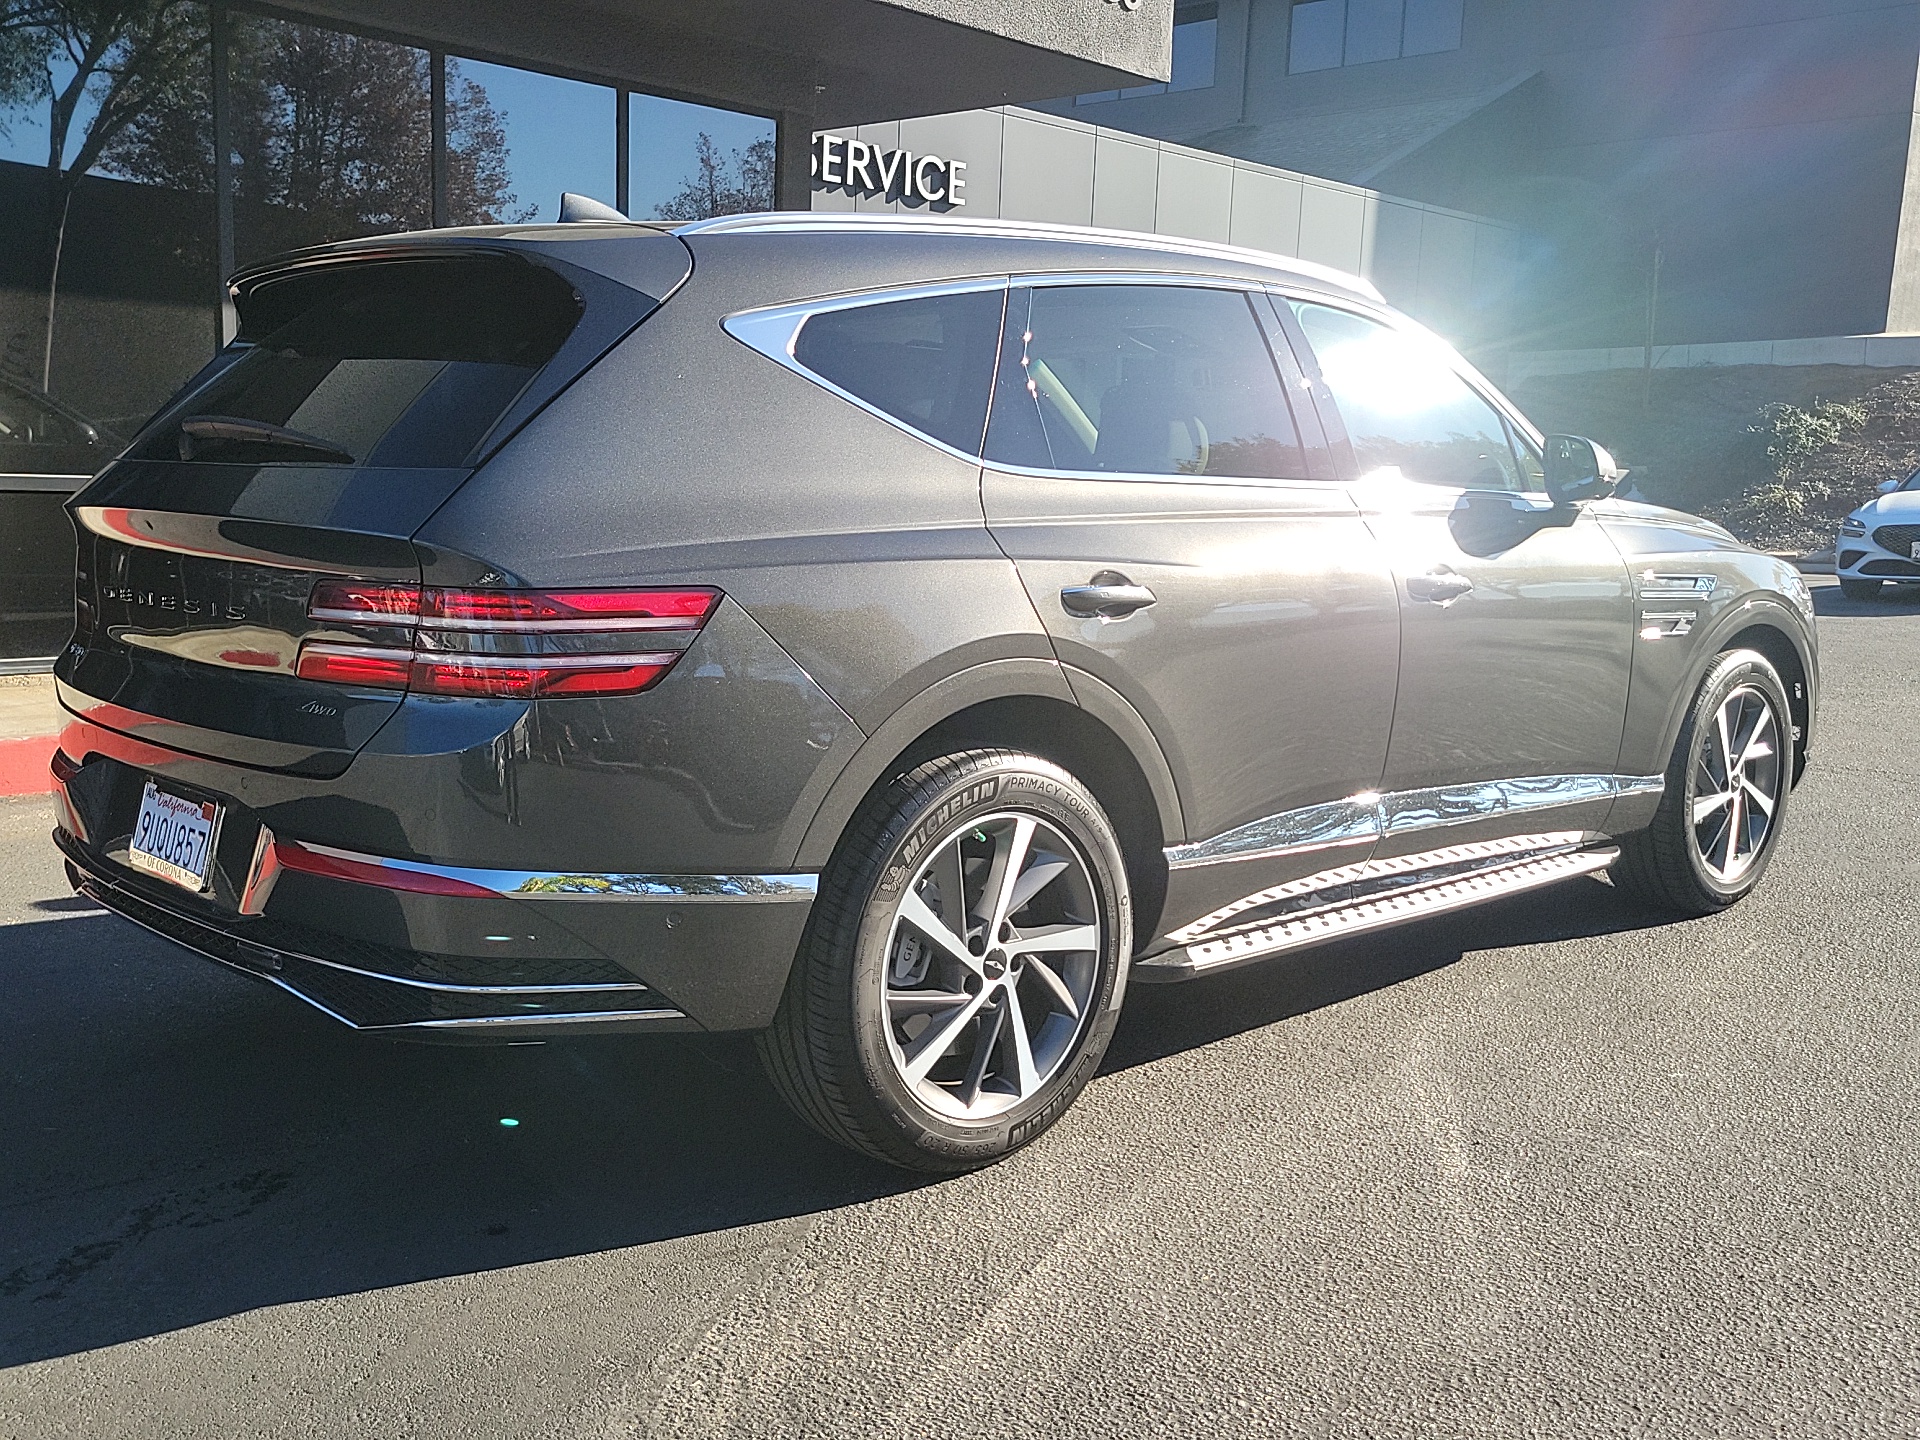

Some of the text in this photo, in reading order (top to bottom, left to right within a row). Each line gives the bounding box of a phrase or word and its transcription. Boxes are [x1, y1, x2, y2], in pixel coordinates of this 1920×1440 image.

[103, 585, 246, 620] GENESIS
[157, 792, 203, 820] California
[902, 781, 995, 863] MICHELIN
[1010, 776, 1061, 796] PRIMACY
[1063, 791, 1090, 818] TOUR
[1091, 818, 1103, 833] A/S
[138, 810, 207, 873] 9UQU857
[147, 856, 181, 879] OF CORONA
